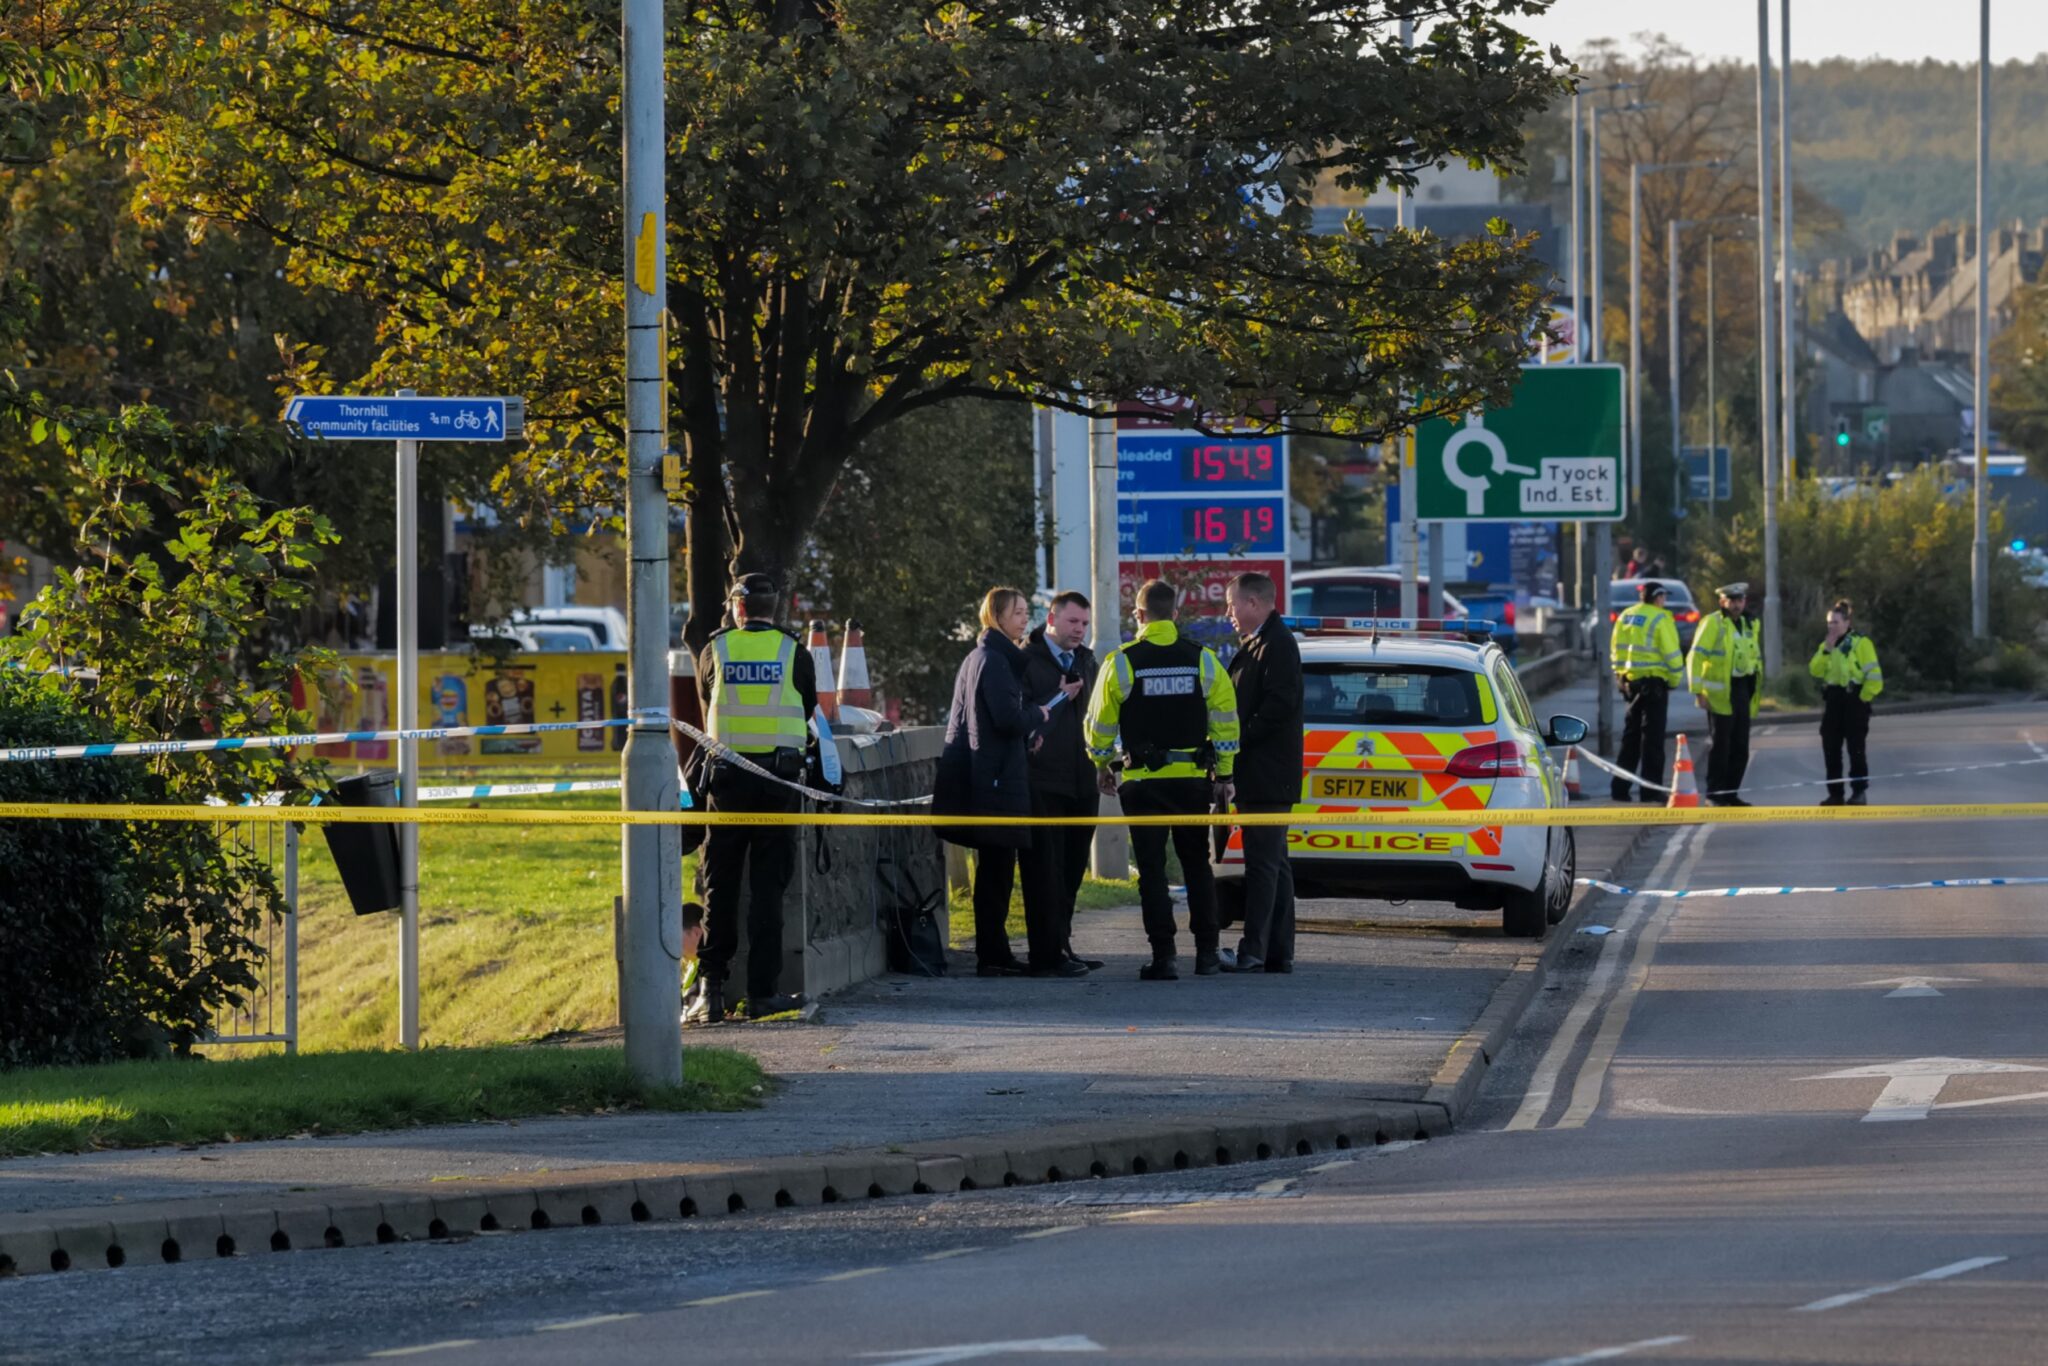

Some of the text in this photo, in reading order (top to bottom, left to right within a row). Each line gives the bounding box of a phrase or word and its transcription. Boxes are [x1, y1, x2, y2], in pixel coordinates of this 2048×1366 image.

[339, 404, 388, 417] Thornhill
[307, 419, 420, 433] community facilities
[1117, 448, 1172, 462] nleaded
[1117, 469, 1135, 480] tre
[1548, 465, 1609, 484] Tyock
[1526, 486, 1609, 502] Ind. Est.
[1119, 511, 1147, 524] esel
[1118, 532, 1135, 542] tre
[1352, 621, 1411, 629] POLICE
[725, 664, 780, 682] POLICE
[1144, 677, 1194, 695] POLICE
[1323, 779, 1408, 798] SF17 ENK
[131, 808, 195, 816] INNER CORDON
[277, 810, 342, 818] INNER CORDON
[1287, 834, 1451, 851] POLICE
